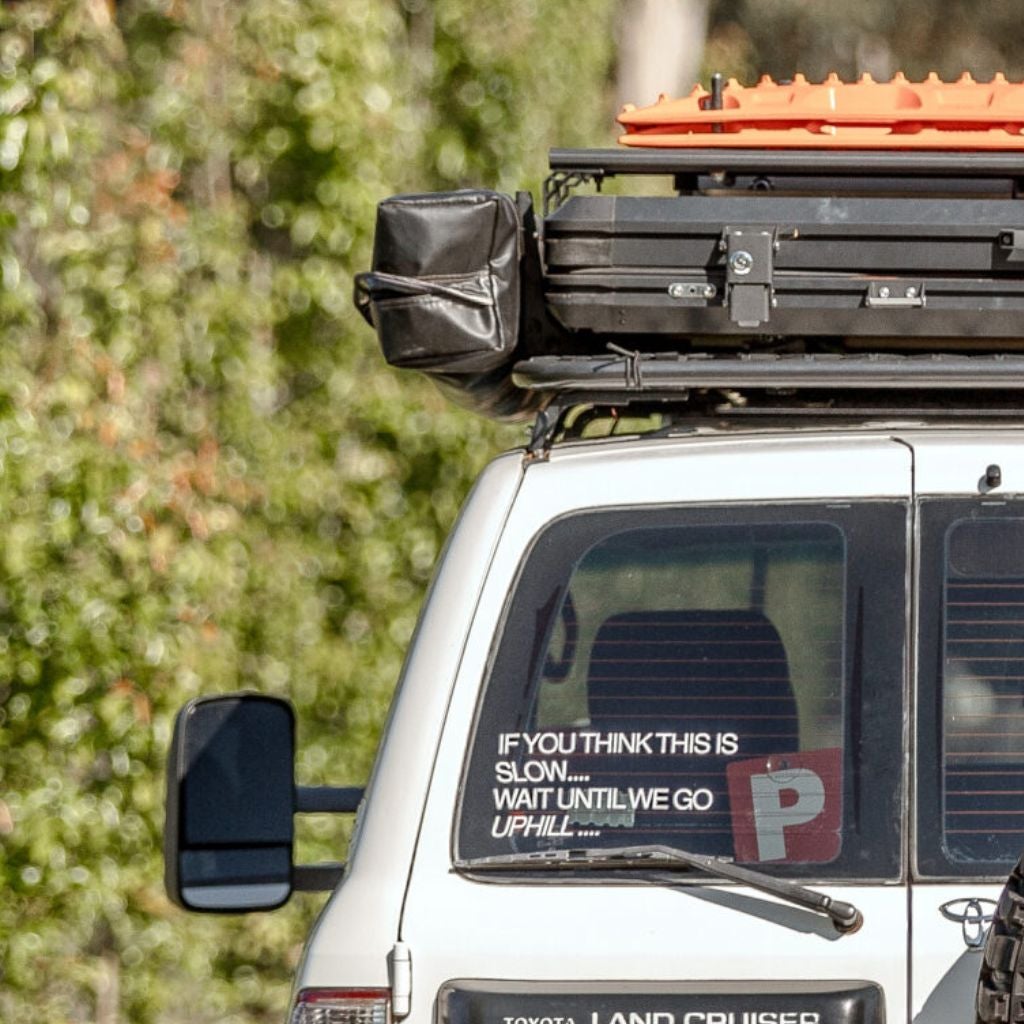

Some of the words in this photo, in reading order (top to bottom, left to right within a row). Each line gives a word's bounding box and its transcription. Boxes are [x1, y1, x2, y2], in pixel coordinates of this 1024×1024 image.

[498, 732, 520, 755] IF
[522, 732, 577, 754] YOU
[579, 732, 653, 754] THINK
[655, 732, 711, 755] THIS
[715, 732, 739, 755] IS
[493, 787, 555, 810] WAIT
[557, 787, 627, 810] UNTIL
[627, 787, 670, 810] WE
[672, 787, 714, 811] GO
[750, 768, 825, 862] P
